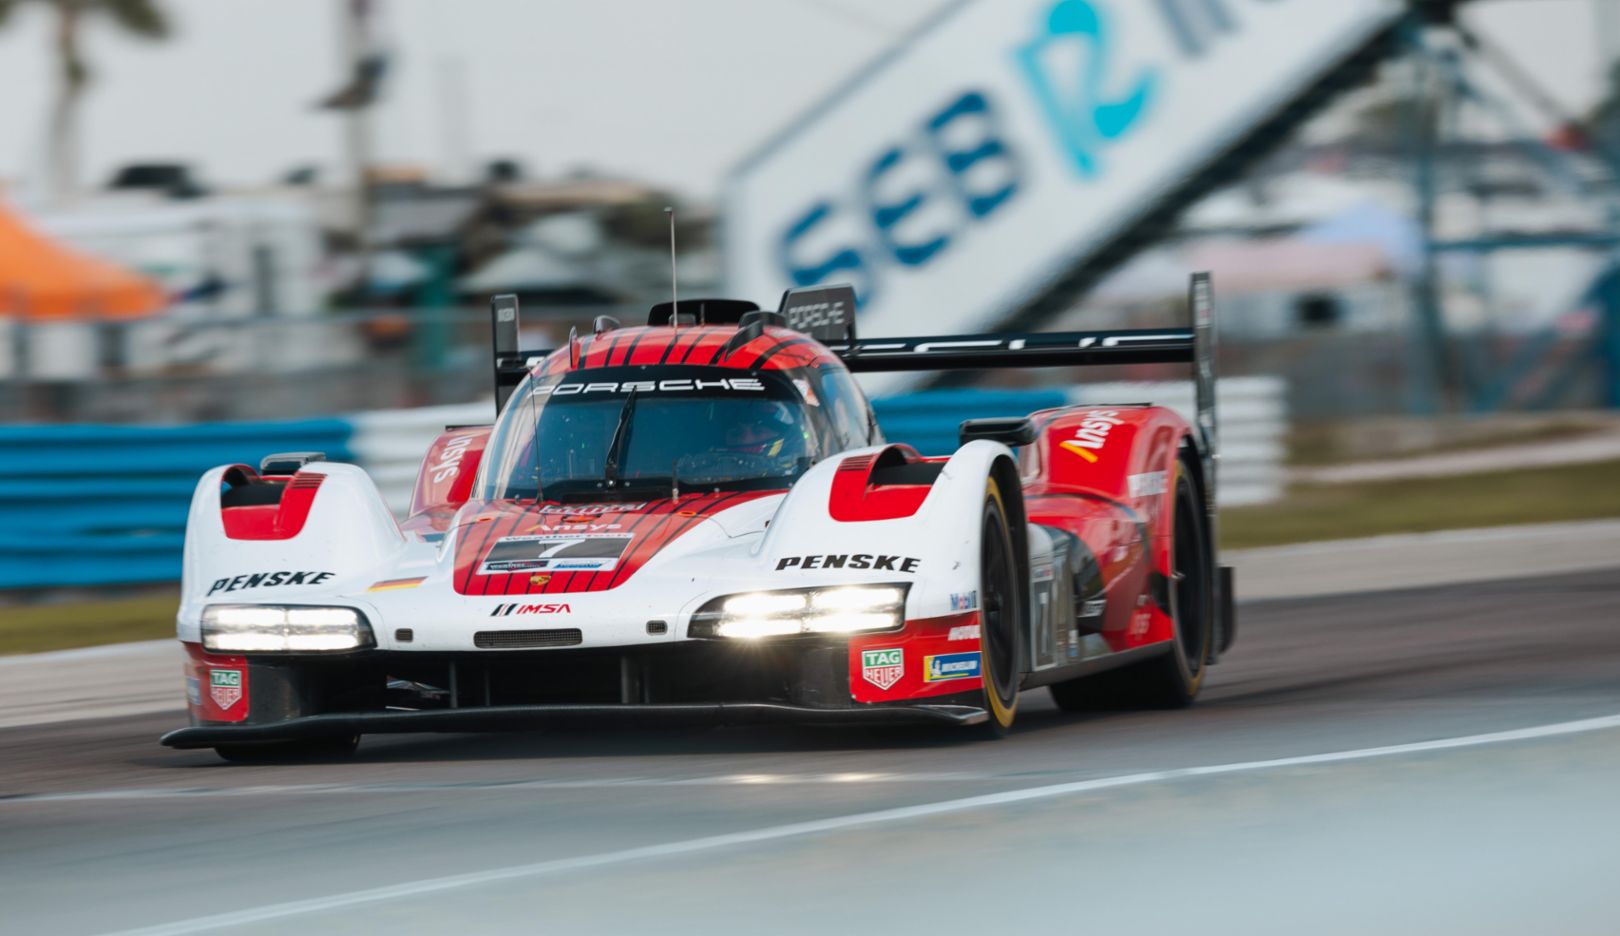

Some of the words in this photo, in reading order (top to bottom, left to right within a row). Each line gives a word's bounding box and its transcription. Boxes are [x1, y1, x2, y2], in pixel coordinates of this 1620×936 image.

[531, 378, 765, 397] PORSCHE
[1060, 409, 1126, 464] Ansys
[528, 523, 622, 532] Ansys
[538, 539, 585, 558] 7
[775, 553, 921, 573] PENSKE
[207, 570, 336, 597] PENSKE
[516, 603, 571, 615] IMSA
[866, 652, 901, 665] TAG
[211, 672, 240, 685] TAG
[865, 667, 902, 686] HEUER
